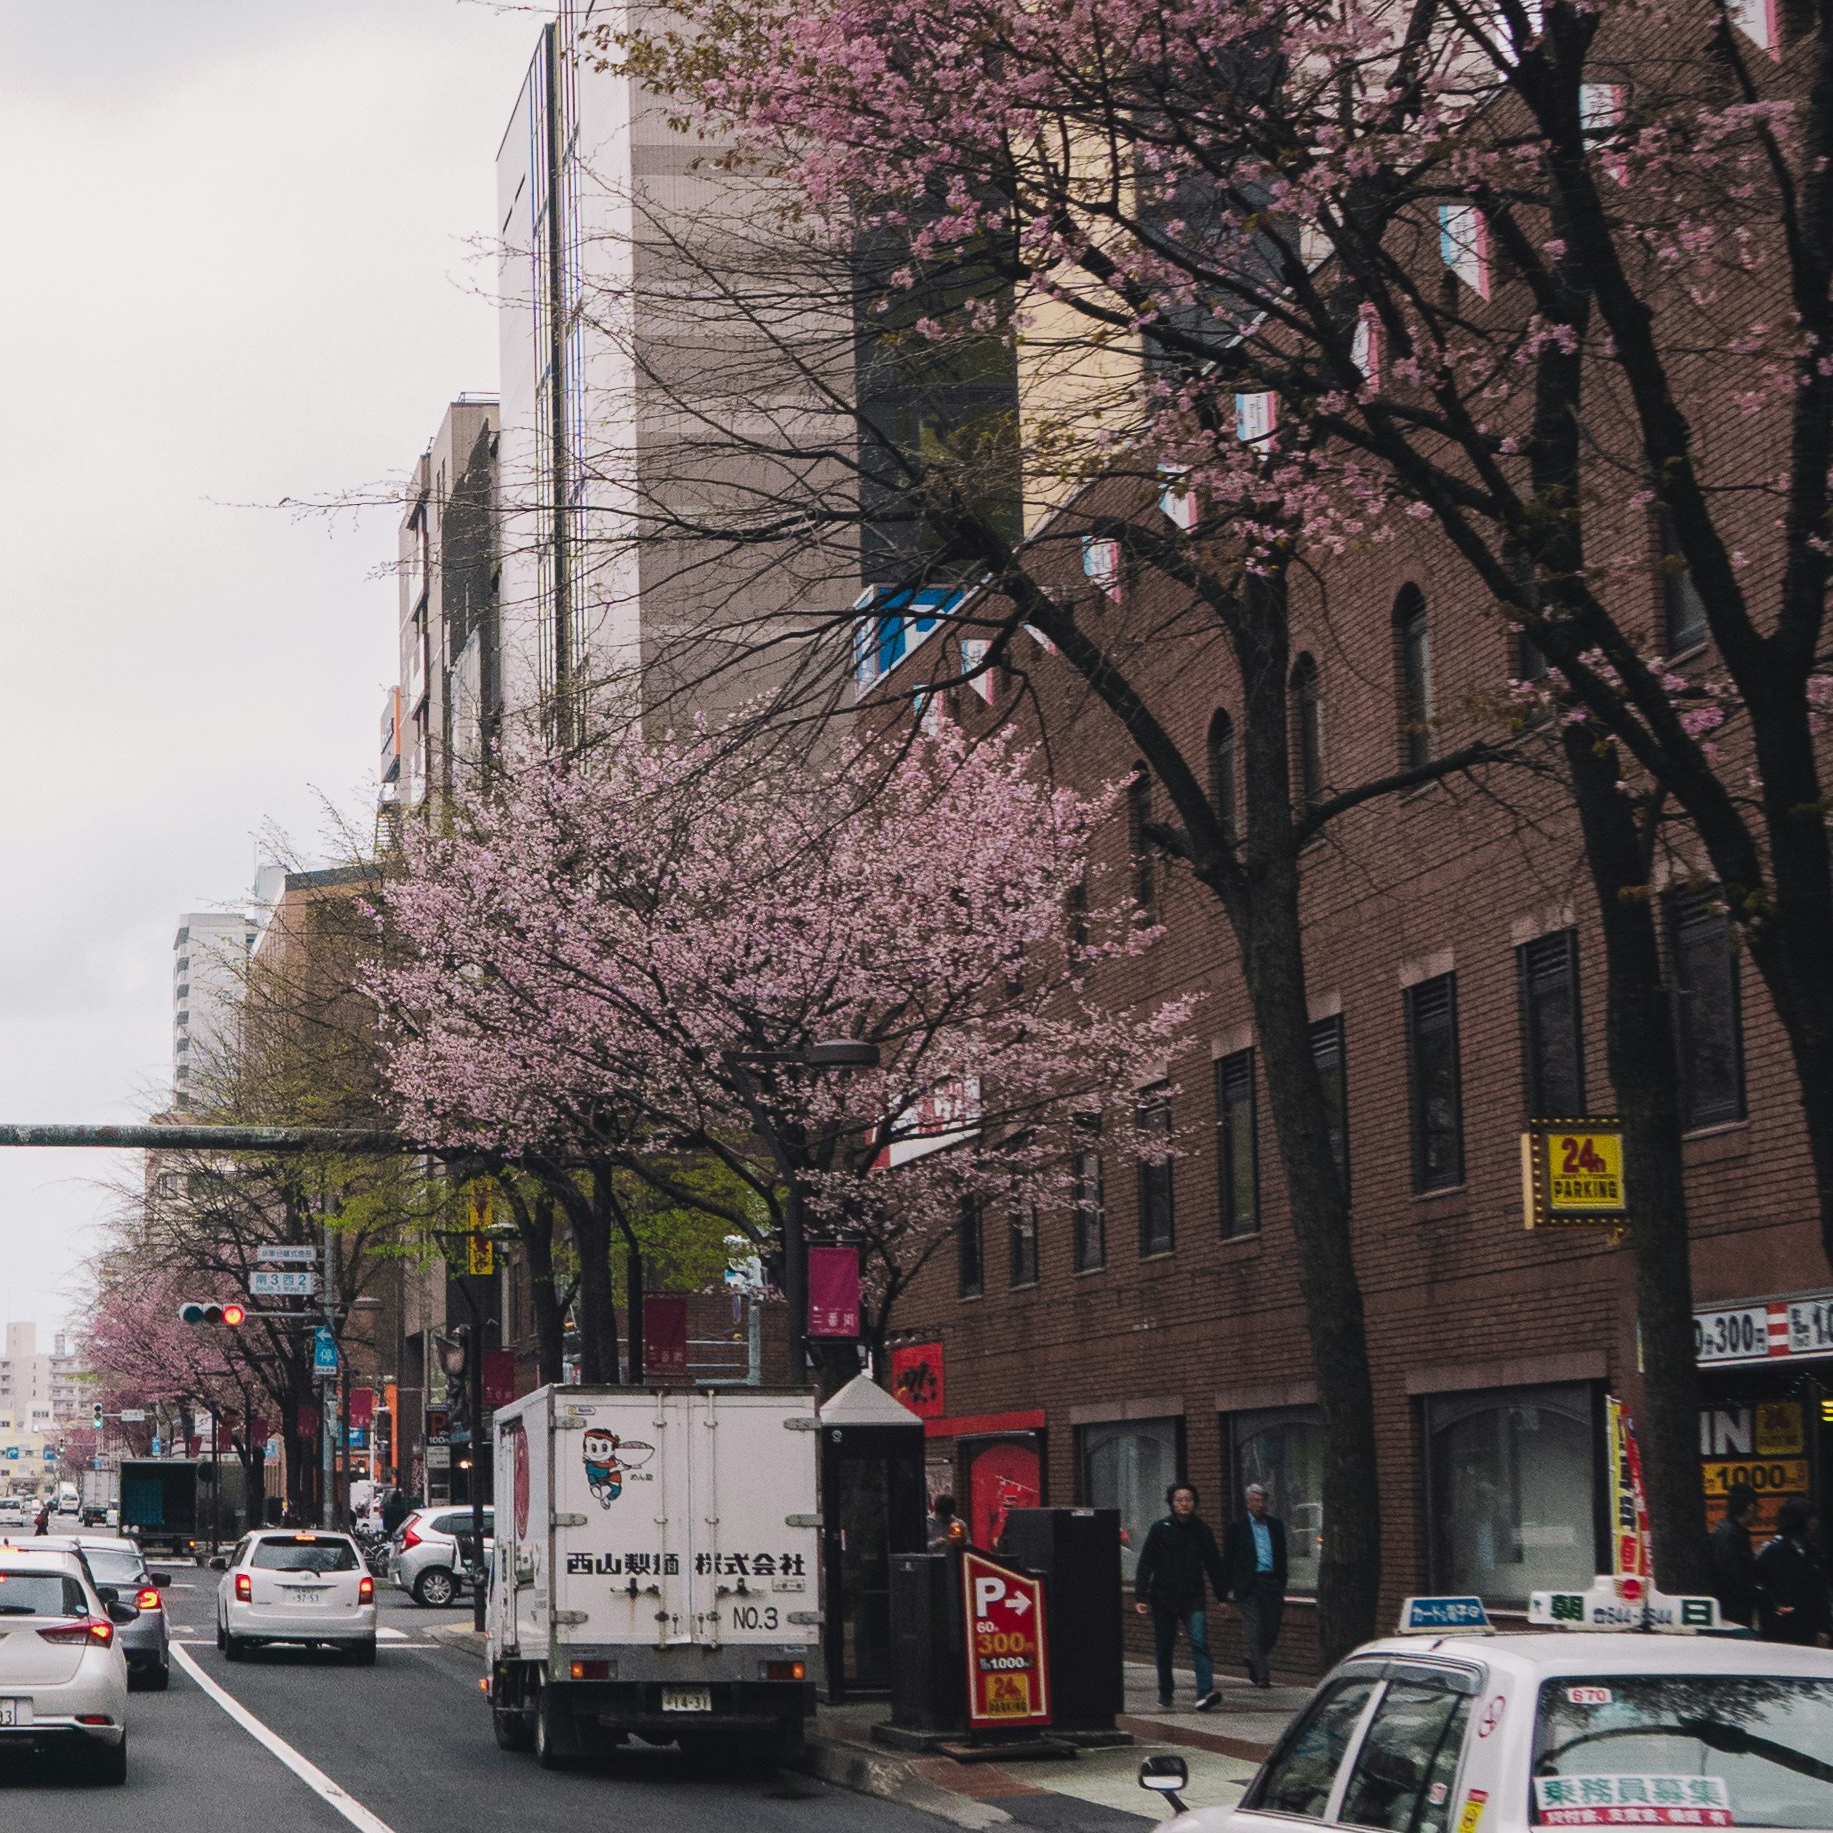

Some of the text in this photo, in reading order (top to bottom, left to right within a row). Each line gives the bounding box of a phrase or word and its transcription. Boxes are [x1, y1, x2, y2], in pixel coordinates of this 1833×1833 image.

[1554, 1180, 1618, 1199] PARKING
[568, 1552, 806, 1576] 西山製麺 株式会社
[975, 1577, 1006, 1617] P
[733, 1607, 779, 1629] NO.3
[1572, 1689, 1606, 1702] 670
[1542, 1776, 1724, 1807] 乗務員募集
